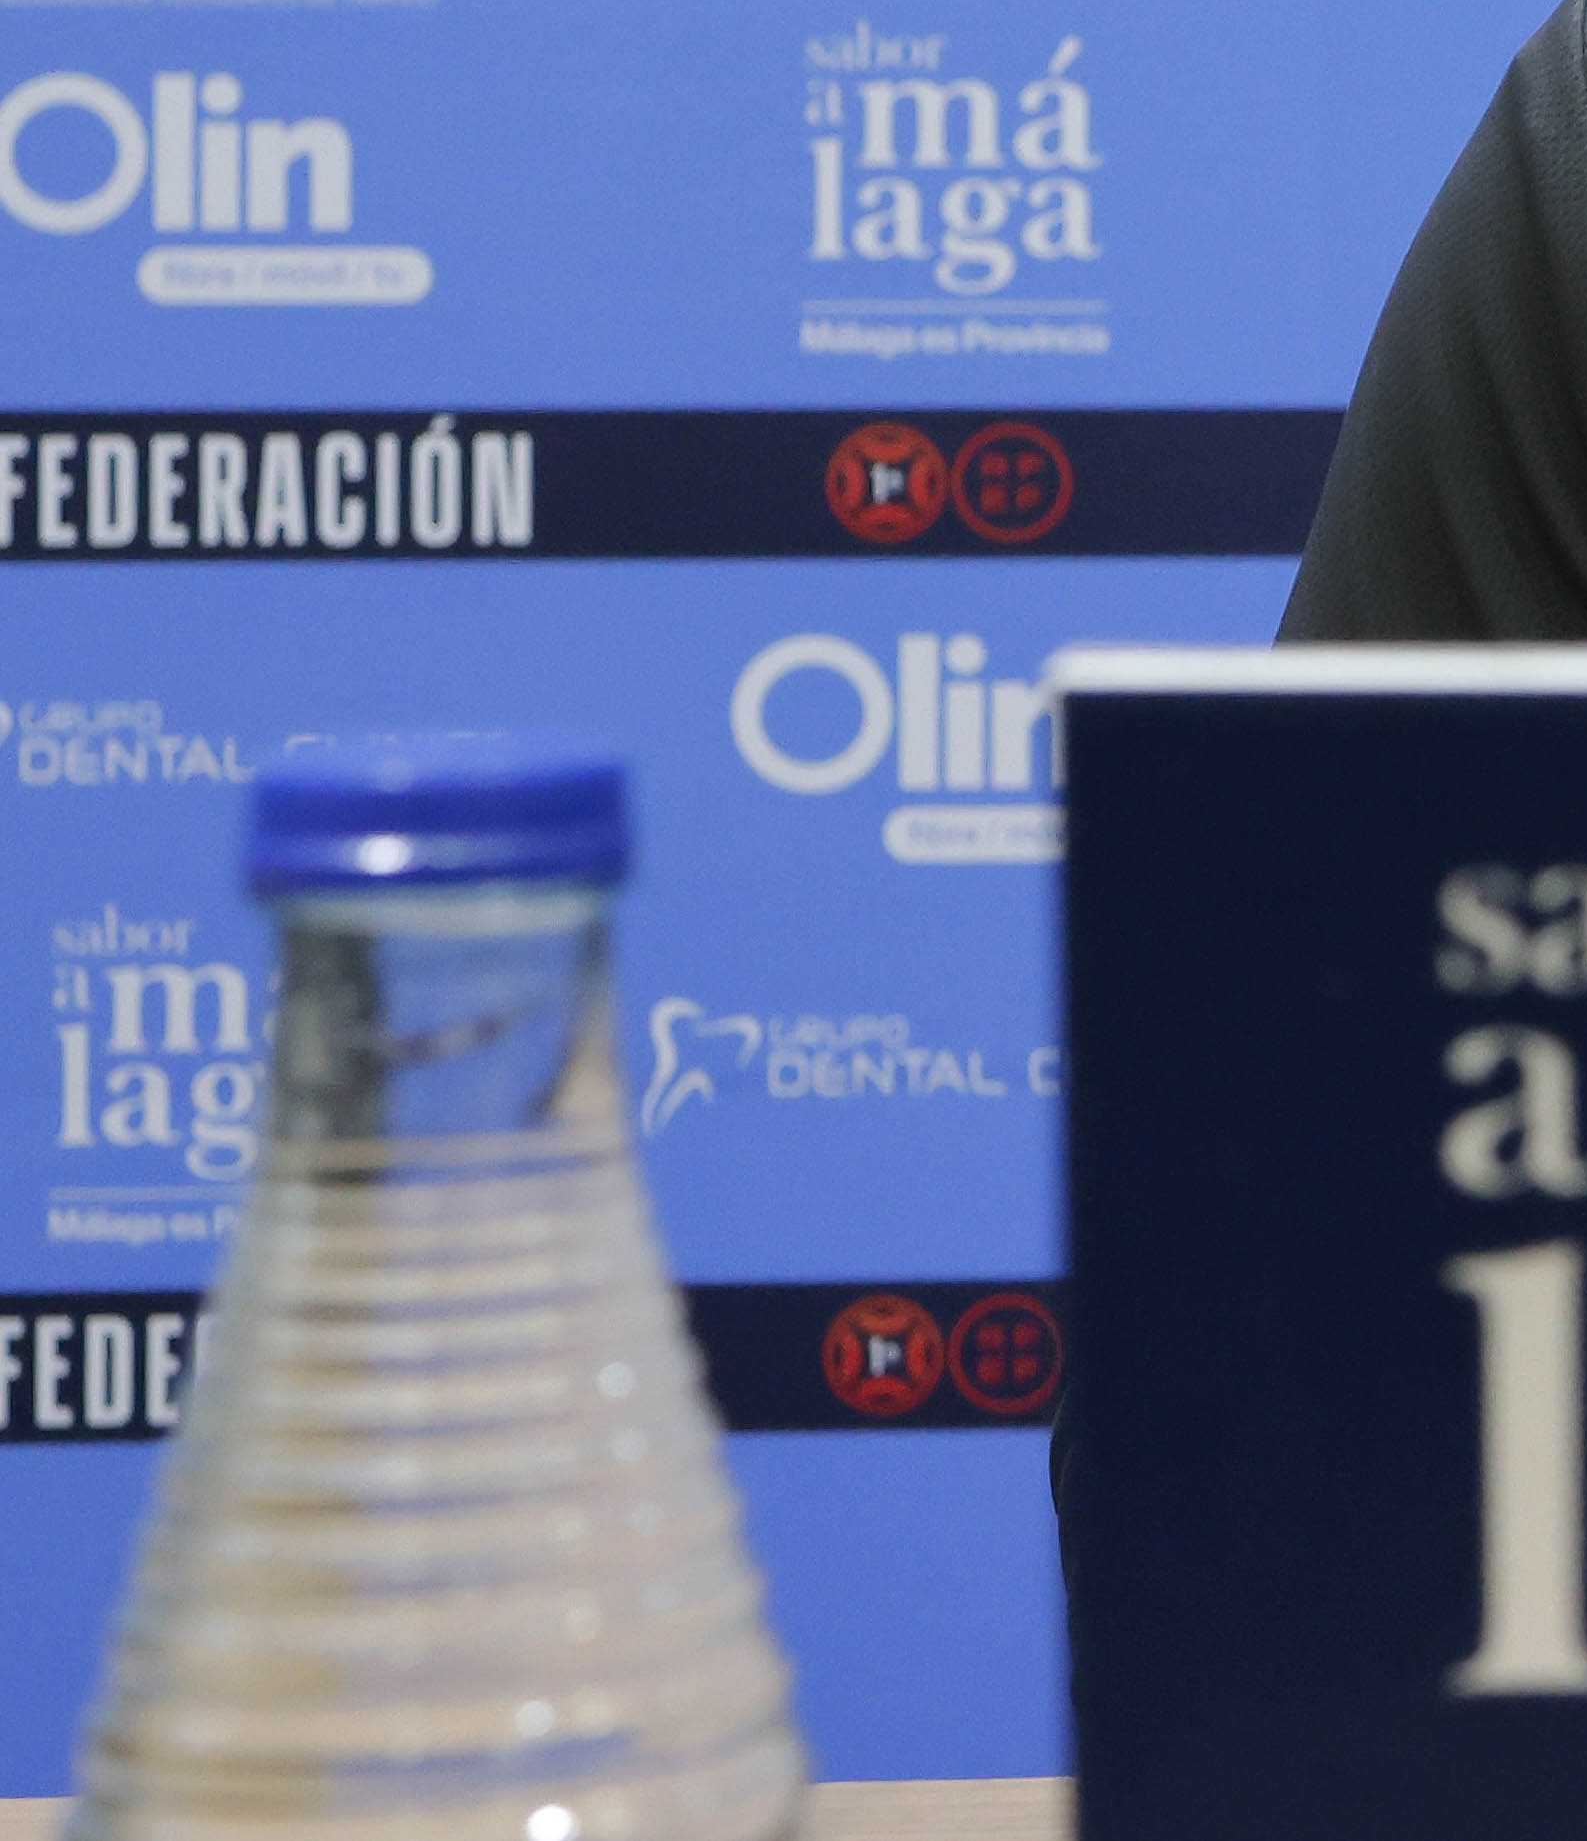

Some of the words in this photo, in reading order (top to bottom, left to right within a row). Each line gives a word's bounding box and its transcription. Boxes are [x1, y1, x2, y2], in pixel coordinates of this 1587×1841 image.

[805, 81, 843, 124] a
[860, 37, 1100, 170] má
[56, 1023, 268, 1181] lag
